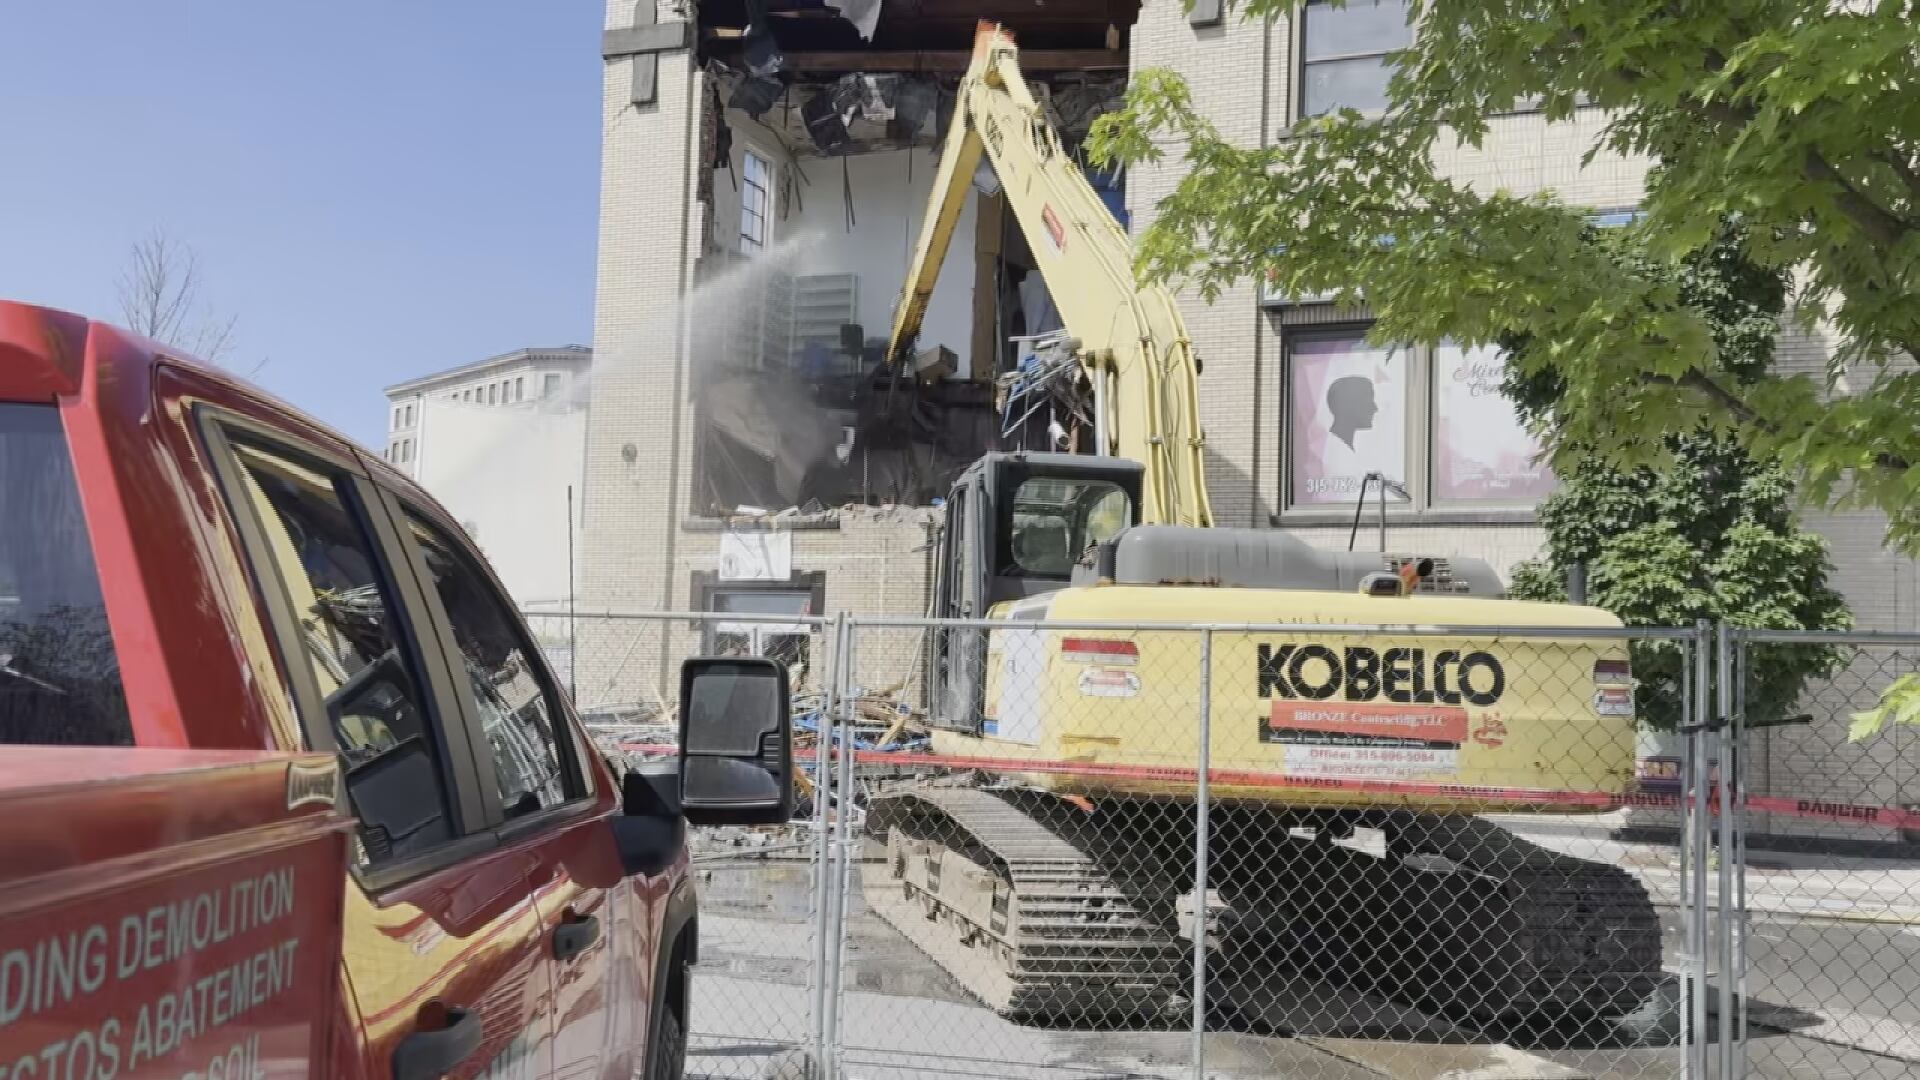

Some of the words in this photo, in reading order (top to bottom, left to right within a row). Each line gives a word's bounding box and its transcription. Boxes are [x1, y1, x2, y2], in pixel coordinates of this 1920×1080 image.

[1257, 643, 1506, 706] KOBELCO
[1294, 710, 1345, 722] BRONZE
[1797, 800, 1879, 822] DANGER
[117, 866, 295, 980] DEMOLITION
[0, 1018, 120, 1080] TOS
[129, 937, 299, 1070] ABATEMENT
